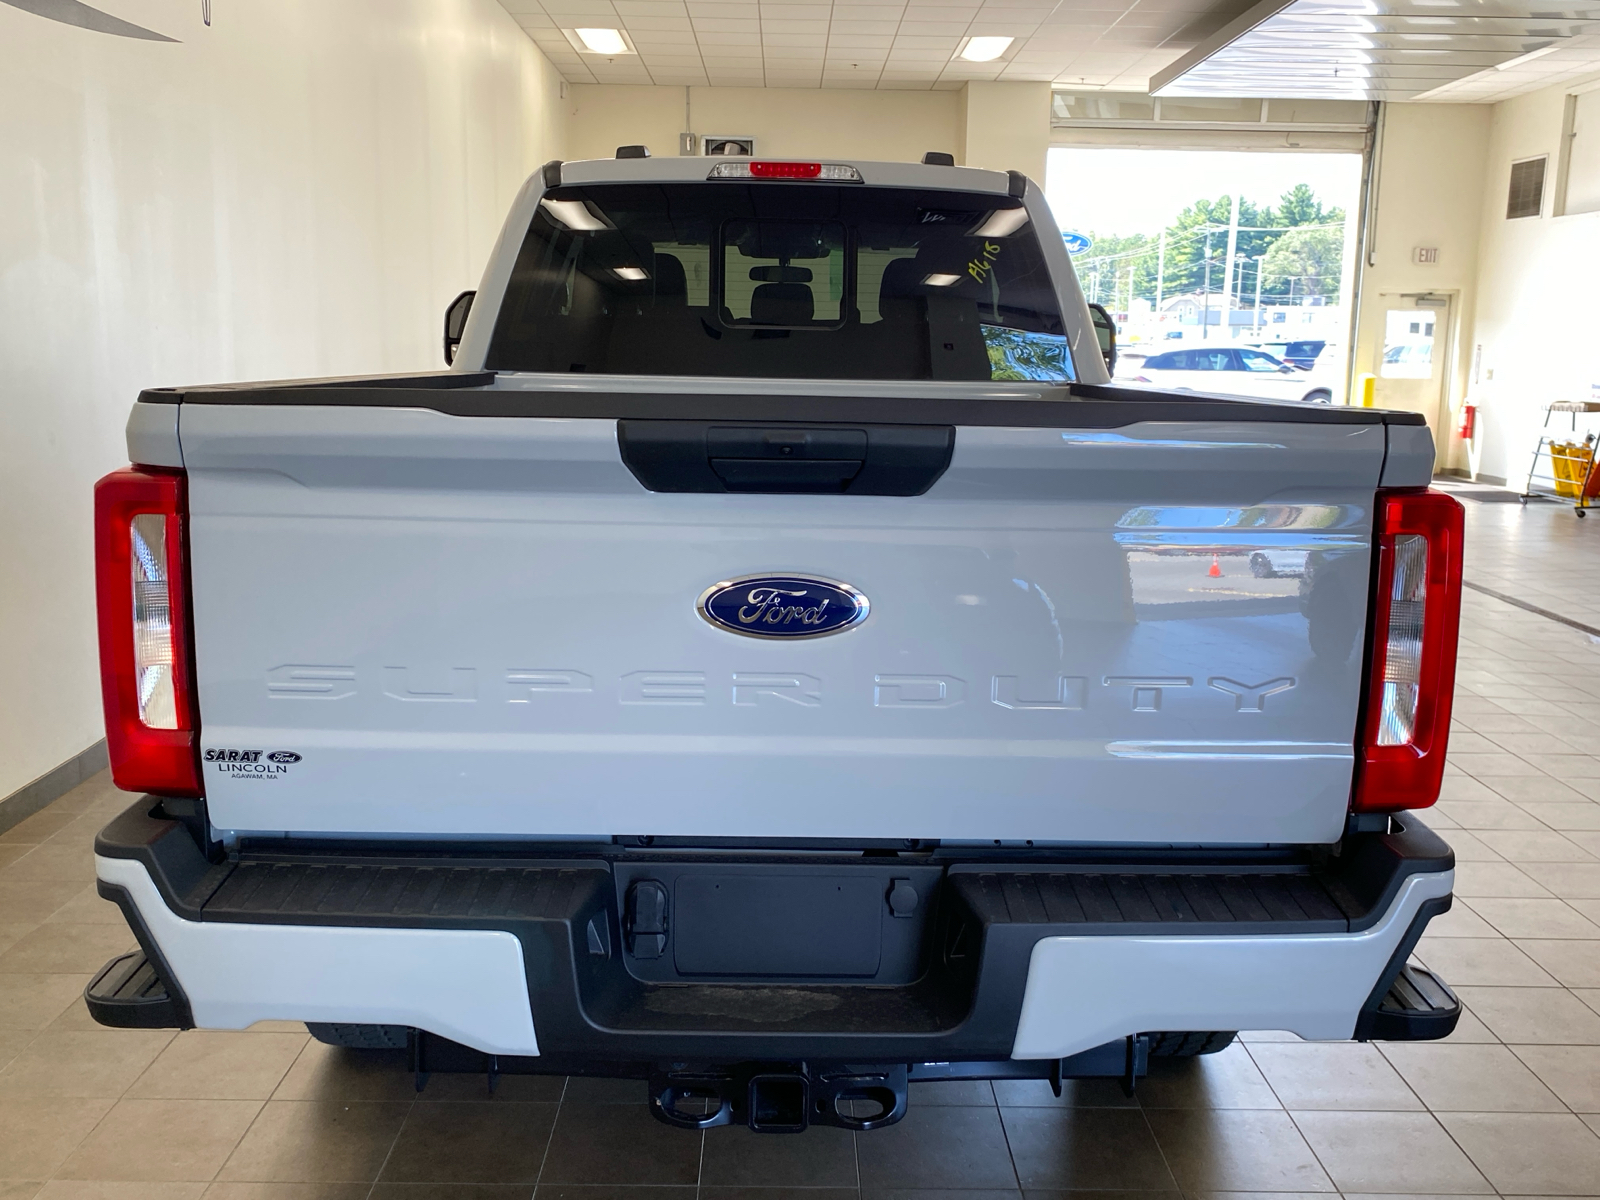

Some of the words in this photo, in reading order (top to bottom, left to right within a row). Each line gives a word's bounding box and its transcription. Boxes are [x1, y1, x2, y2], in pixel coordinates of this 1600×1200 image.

[1418, 248, 1438, 263] EXIT
[738, 587, 830, 625] Ford
[266, 663, 823, 708] SUPER
[873, 672, 1298, 714] DUTY
[204, 748, 263, 763] SARAT
[218, 763, 287, 773] LINCOLN
